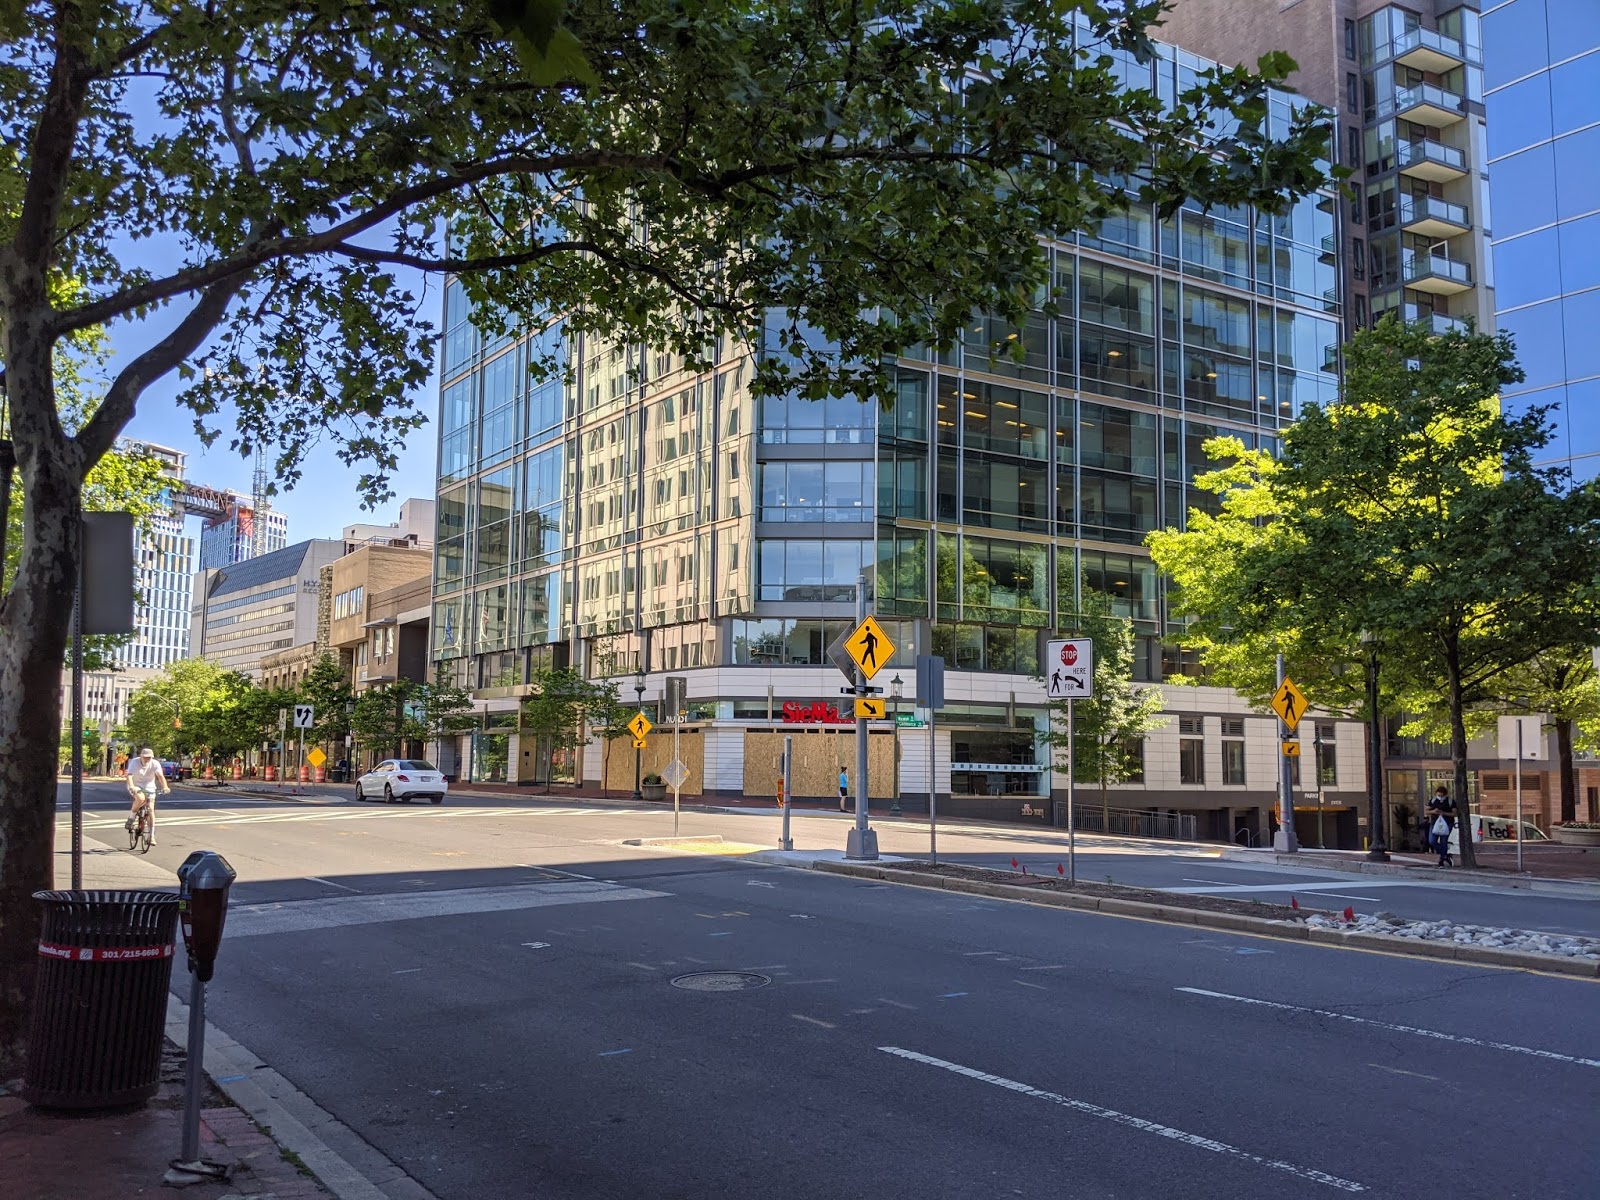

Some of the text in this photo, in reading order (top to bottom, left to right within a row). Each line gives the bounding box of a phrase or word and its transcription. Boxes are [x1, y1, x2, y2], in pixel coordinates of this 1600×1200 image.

[1061, 650, 1077, 660] STOP
[1072, 667, 1087, 675] HERE
[1064, 683, 1075, 691] FOR
[782, 700, 857, 724] SieMa
[1487, 821, 1518, 840] FedE
